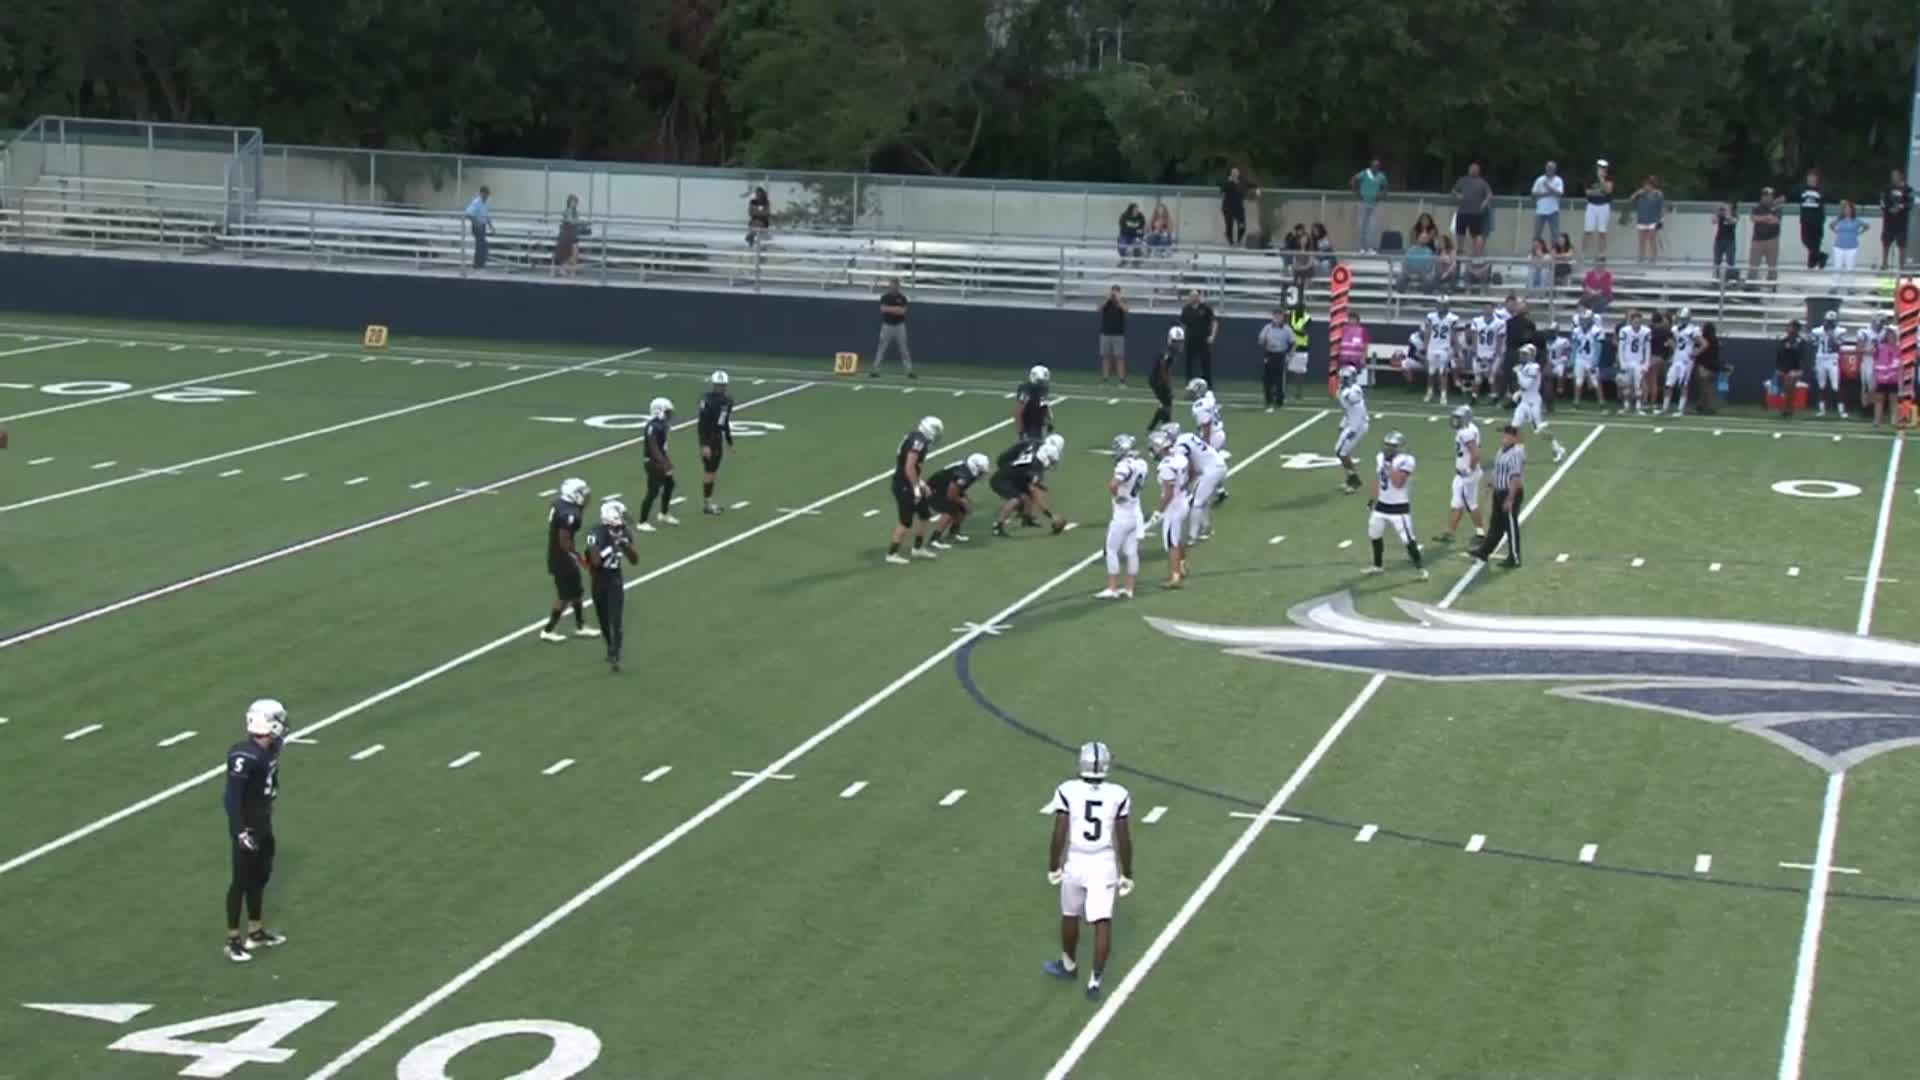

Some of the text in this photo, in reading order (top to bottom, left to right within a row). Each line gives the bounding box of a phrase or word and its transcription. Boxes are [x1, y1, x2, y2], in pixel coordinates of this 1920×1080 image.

[1286, 286, 1299, 305] 3
[367, 327, 383, 344] 20
[1431, 324, 1448, 339] 52
[1631, 337, 1640, 353] 6
[838, 355, 853, 370] 30
[233, 757, 246, 773] 5
[1083, 800, 1103, 842] 5
